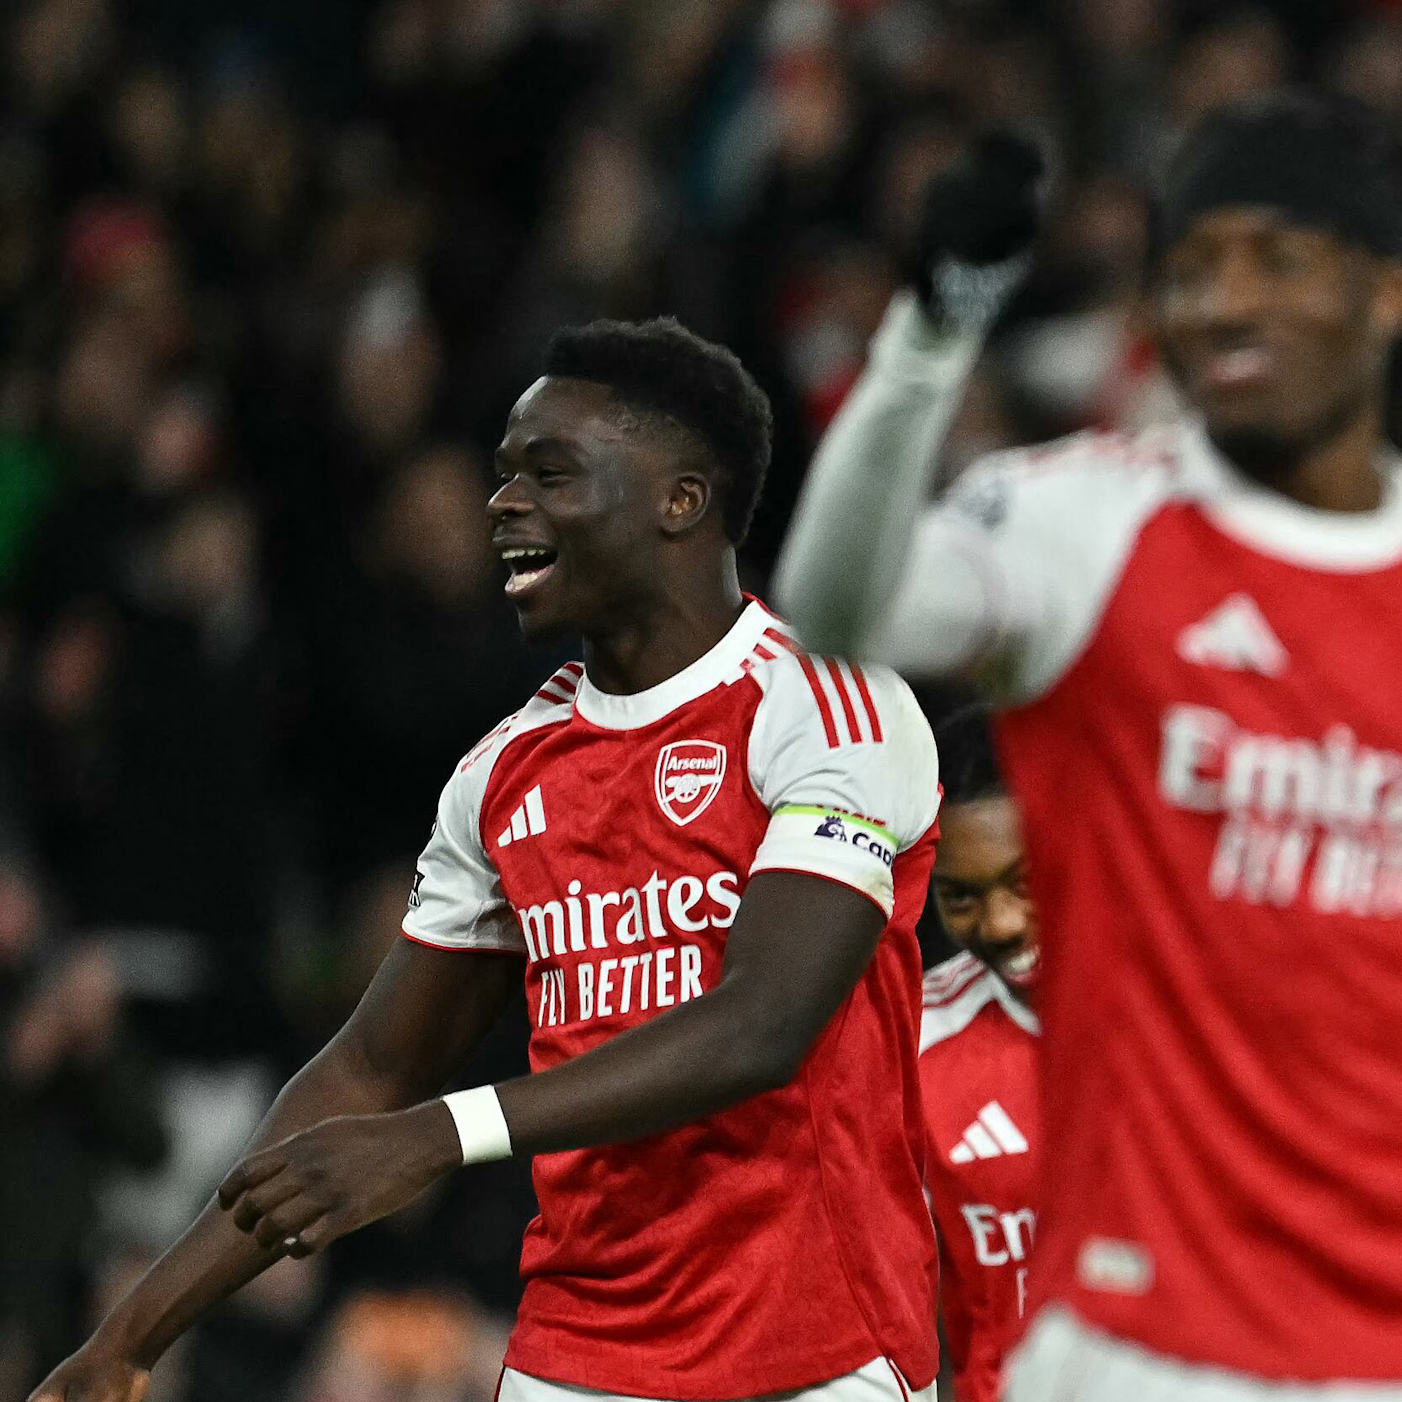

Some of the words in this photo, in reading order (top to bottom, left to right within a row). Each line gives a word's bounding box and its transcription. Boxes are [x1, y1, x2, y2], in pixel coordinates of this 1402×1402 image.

[667, 755, 718, 770] Arsenal
[514, 868, 743, 965] mirates
[538, 968, 566, 1028] FLY
[577, 943, 705, 1022] BETTER
